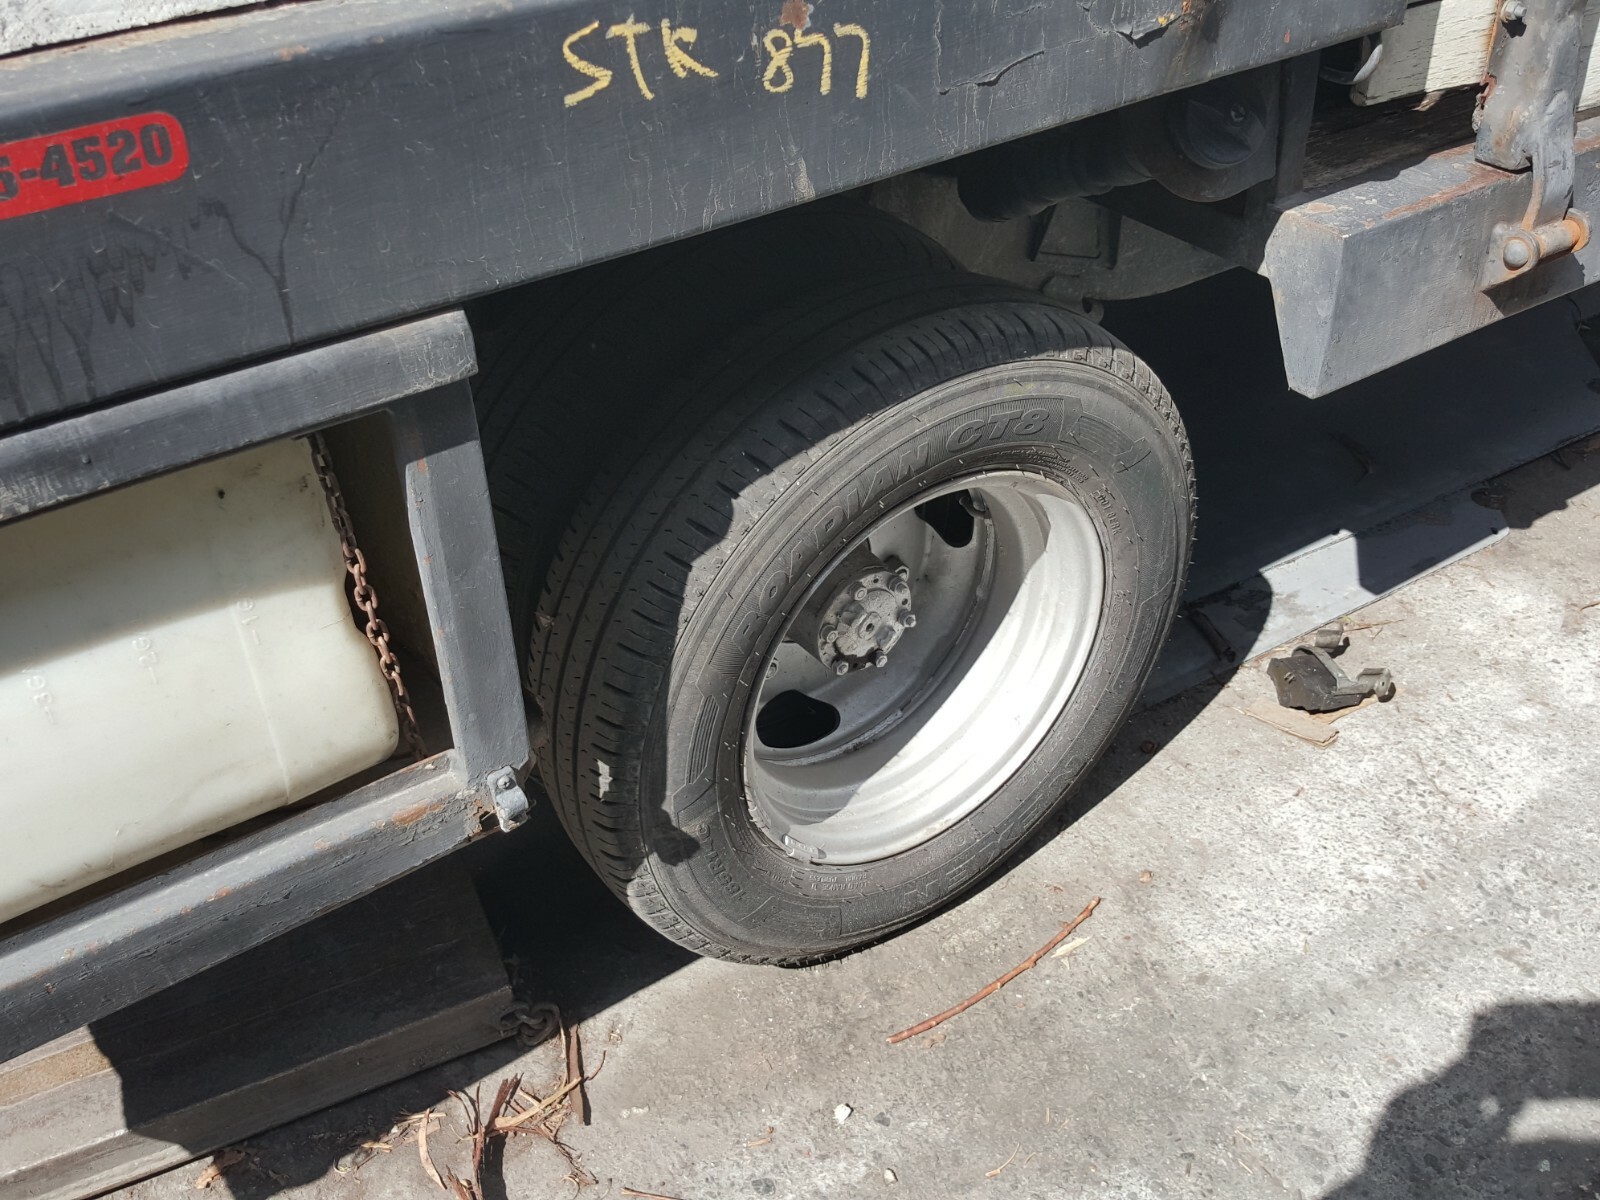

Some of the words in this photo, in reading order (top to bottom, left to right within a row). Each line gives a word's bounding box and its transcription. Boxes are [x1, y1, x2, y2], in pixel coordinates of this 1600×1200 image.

[563, 13, 719, 108] STK
[731, 440, 931, 656] ROADIAN
[946, 408, 1049, 450] CT8
[897, 755, 1088, 914] NEXEN
